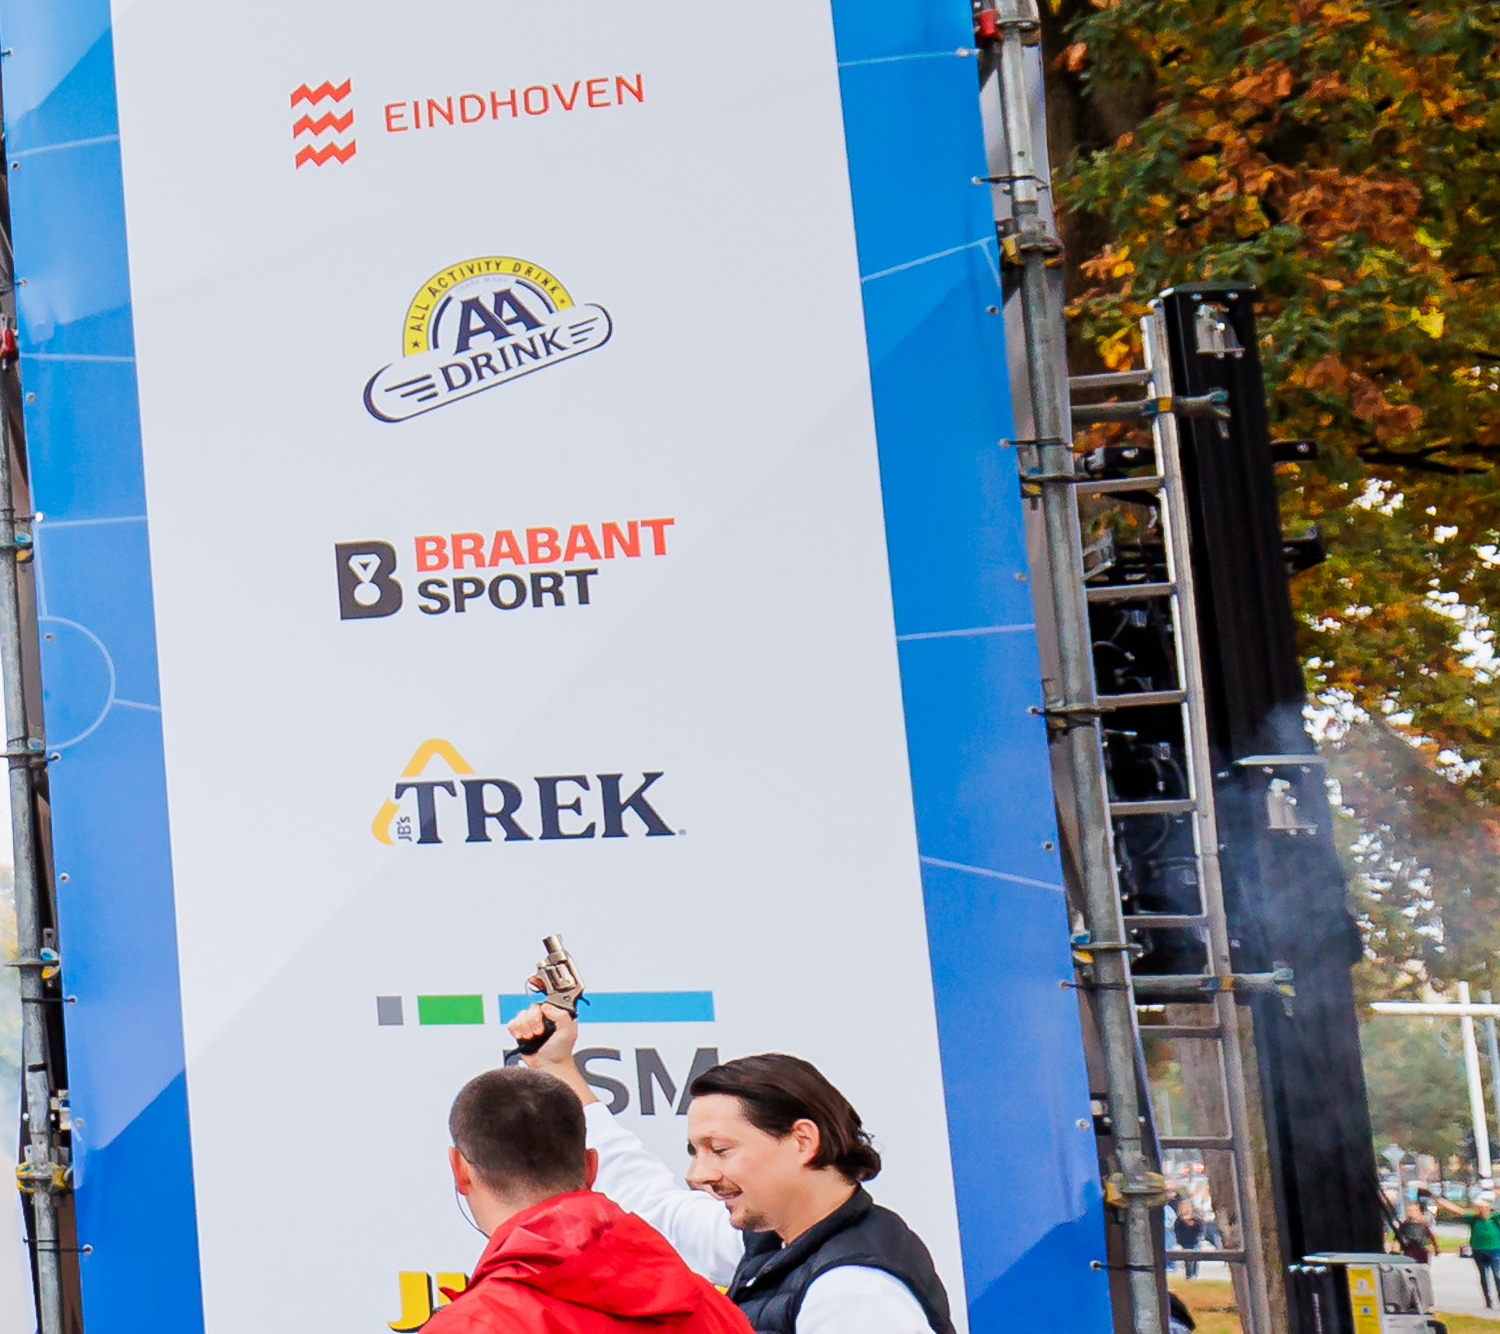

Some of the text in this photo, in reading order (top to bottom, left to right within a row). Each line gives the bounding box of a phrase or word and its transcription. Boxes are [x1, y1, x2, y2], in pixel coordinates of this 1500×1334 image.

[383, 71, 646, 134] EINDHOVEN
[410, 259, 561, 333] ALL ACTIVITY DRINK
[453, 287, 547, 356] AA
[439, 324, 571, 394] DRINK
[413, 517, 676, 573] BRABANT
[417, 567, 599, 616] SPORT
[394, 770, 676, 845] TREK
[503, 1047, 719, 1116] SM
